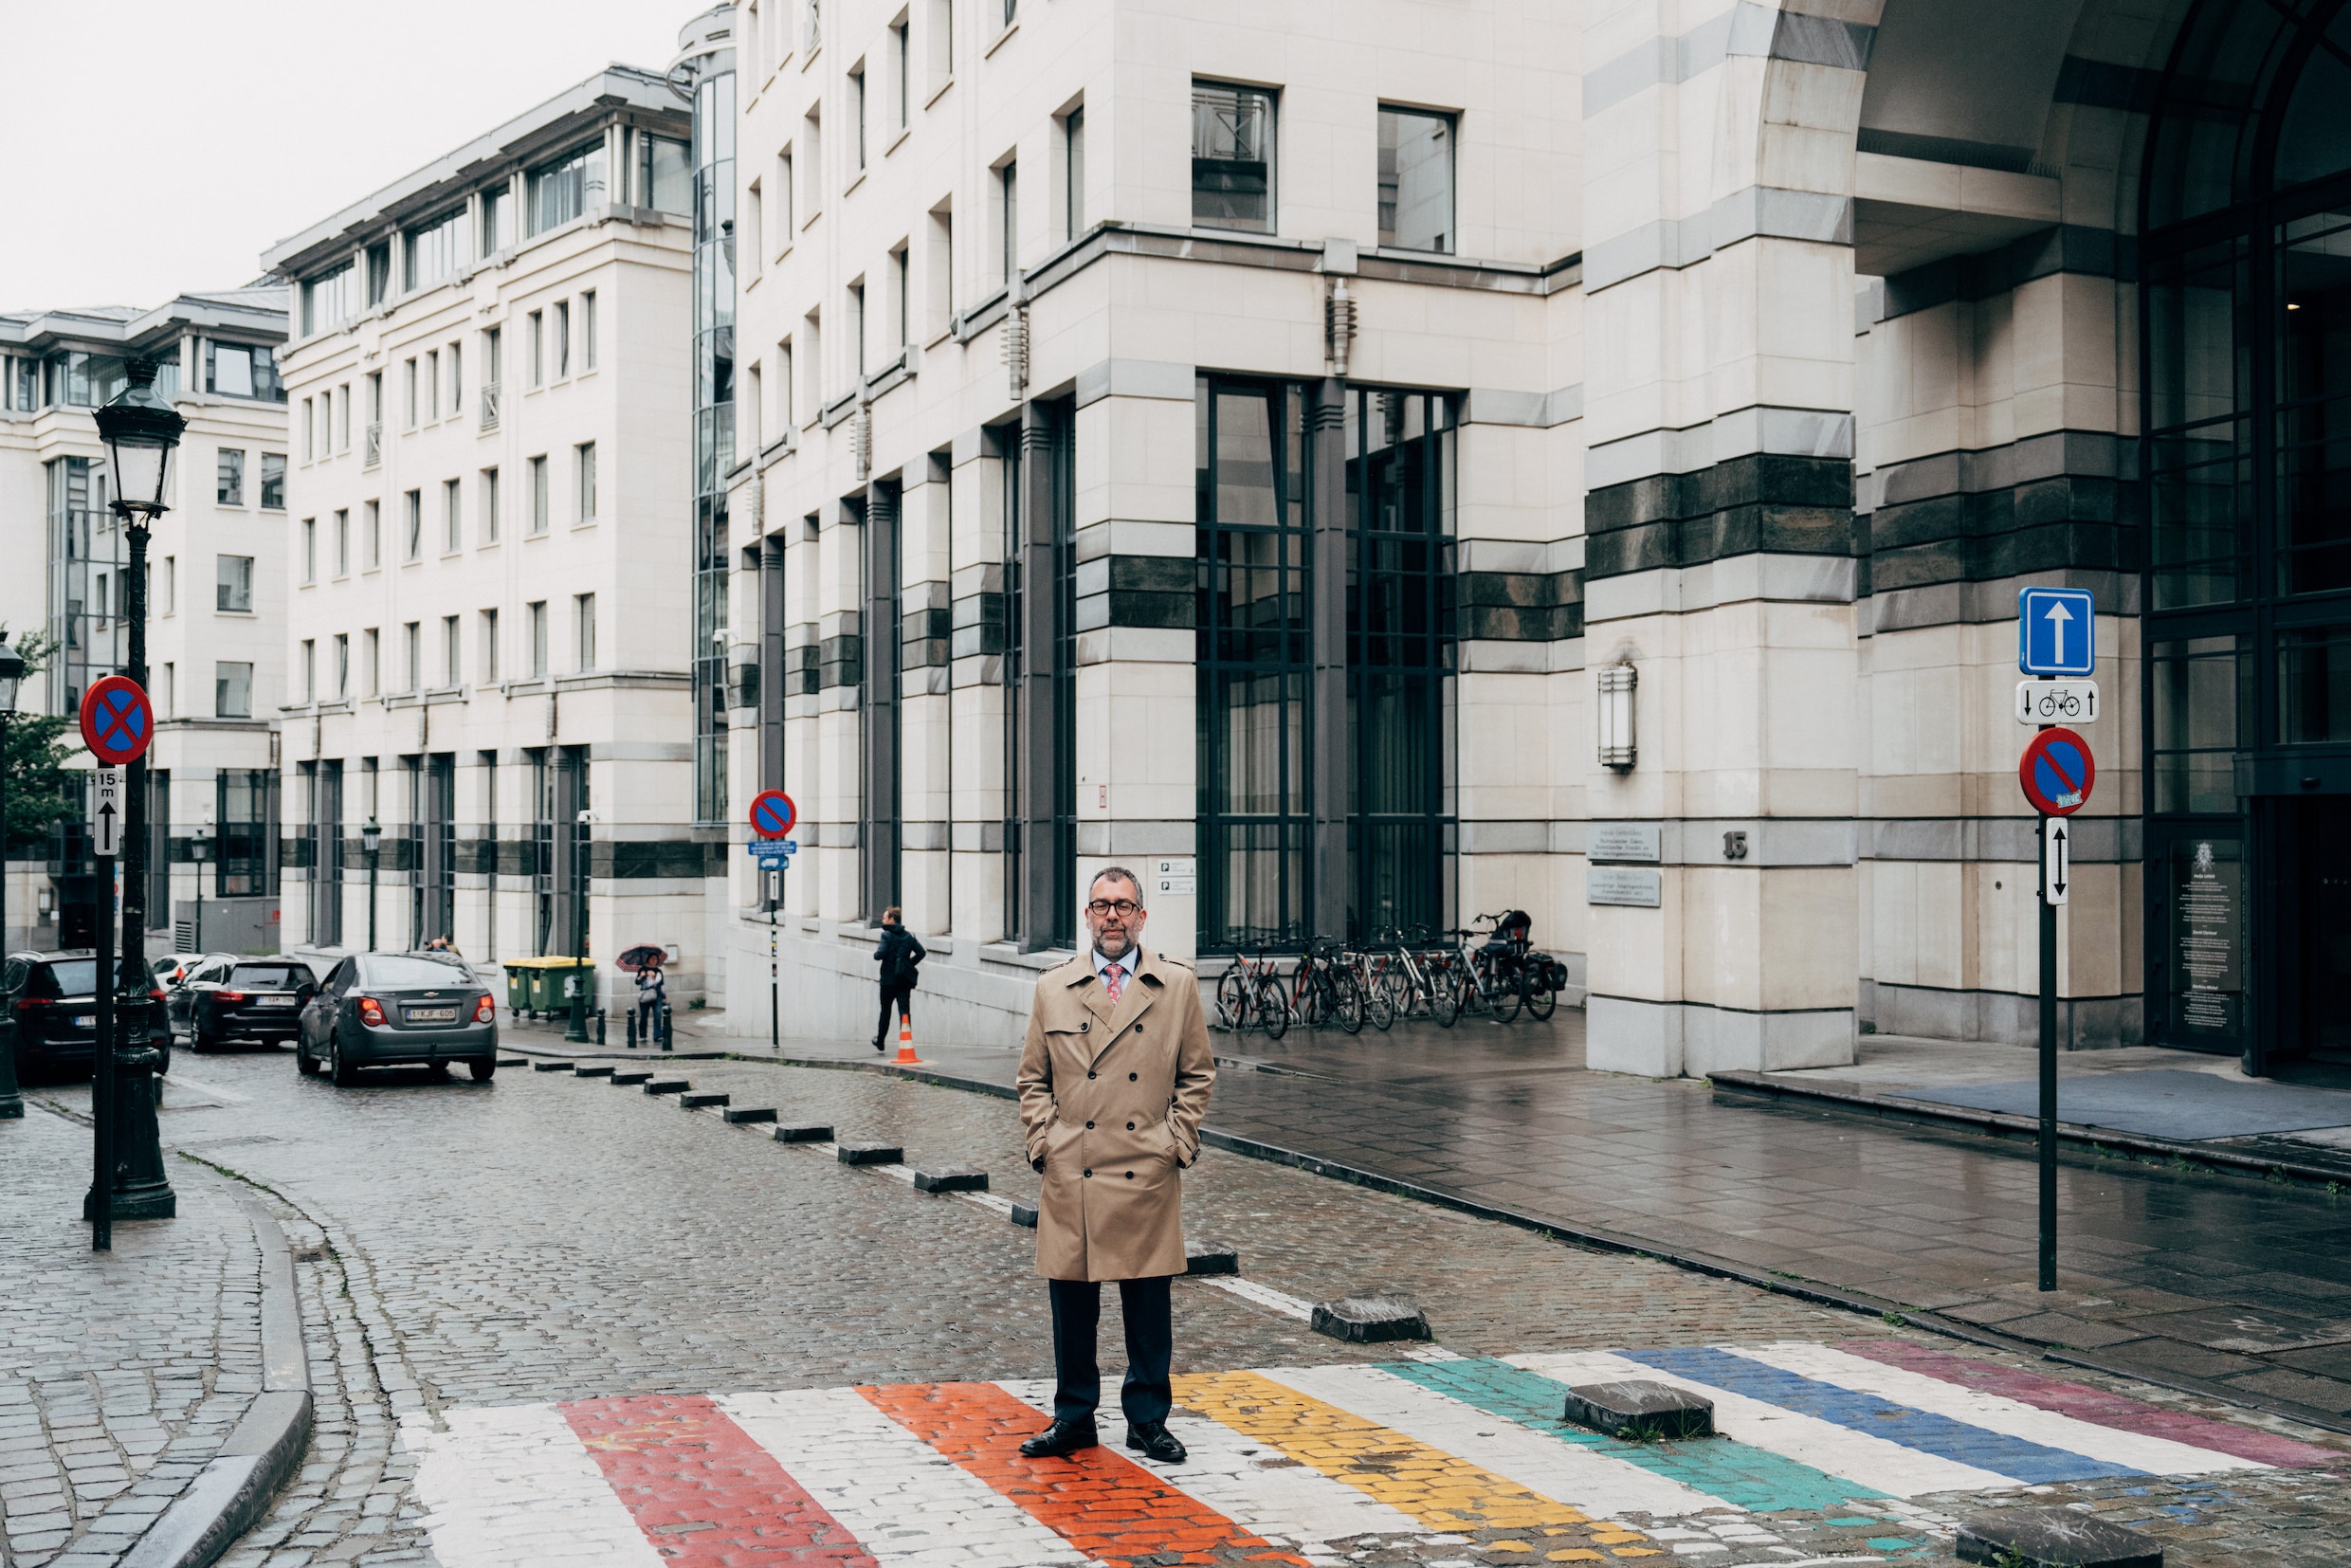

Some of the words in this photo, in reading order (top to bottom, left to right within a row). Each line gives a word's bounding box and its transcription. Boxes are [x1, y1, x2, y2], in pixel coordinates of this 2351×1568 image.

[100, 774, 115, 785] 15
[101, 789, 114, 797] m
[1723, 831, 1747, 858] 15
